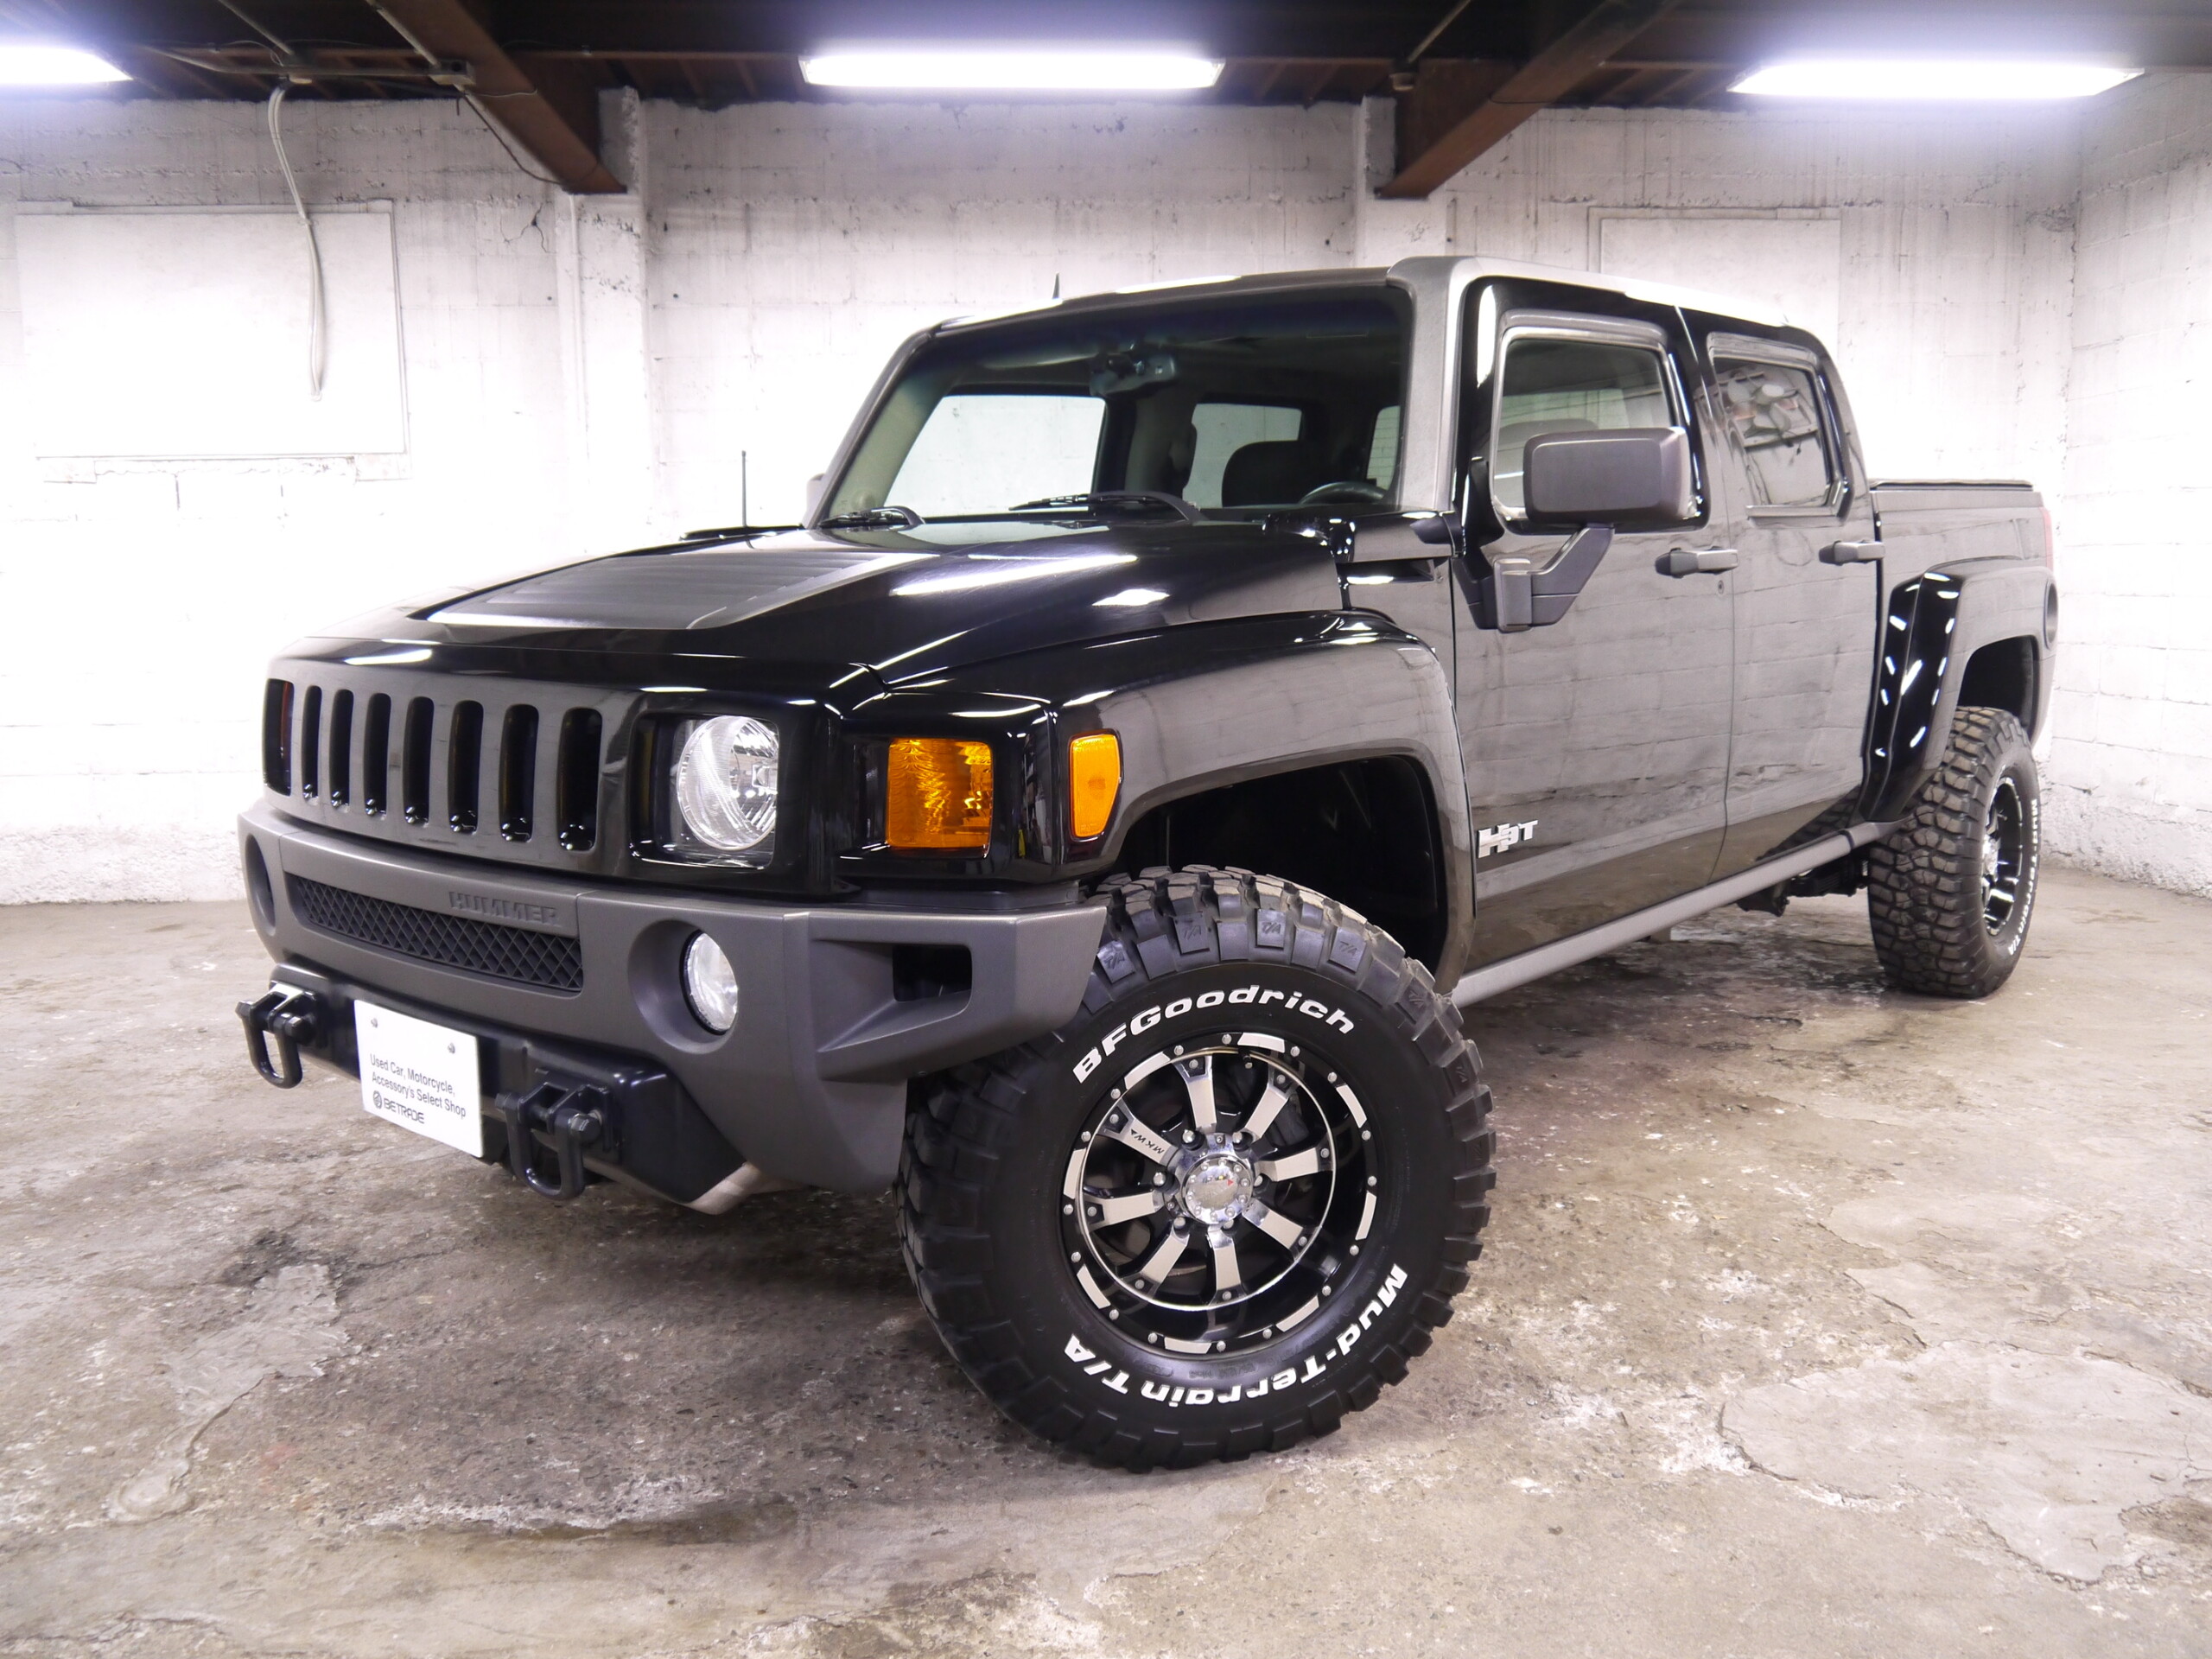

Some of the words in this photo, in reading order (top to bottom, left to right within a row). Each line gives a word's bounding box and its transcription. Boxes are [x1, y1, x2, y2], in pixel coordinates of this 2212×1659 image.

[1477, 819, 1538, 859] H3T
[448, 891, 563, 928] HUMMER
[1071, 985, 1355, 1084] BFGoodrich
[369, 1052, 389, 1071] Used
[390, 1061, 406, 1080] Car,
[407, 1067, 456, 1097] Motorcycle,
[372, 1071, 415, 1099] Accessory's
[416, 1088, 442, 1109] Select
[444, 1098, 467, 1121] Shop
[383, 1097, 425, 1124] BETRADE
[1141, 1263, 1408, 1408] Mud-Terrain
[1064, 1333, 1129, 1395] T/A
